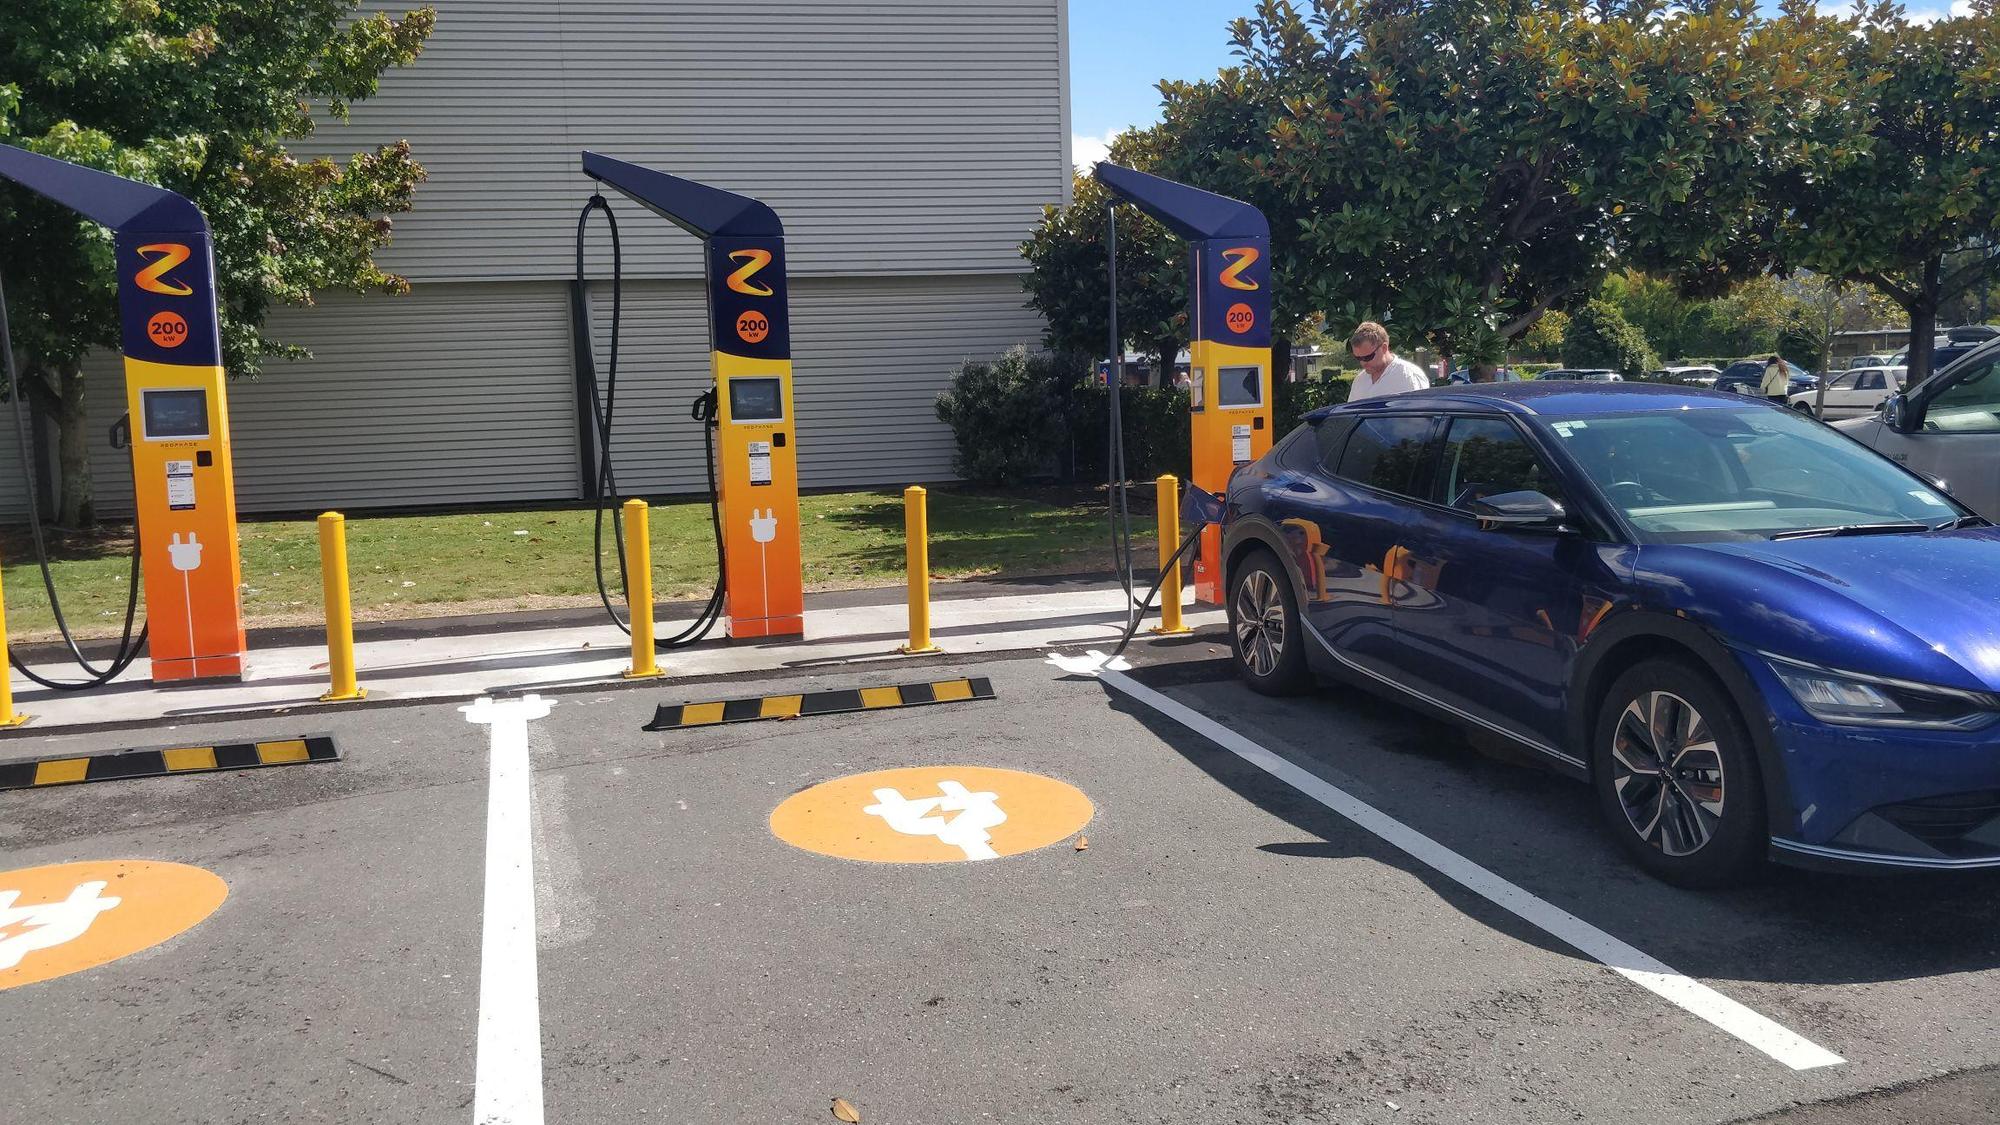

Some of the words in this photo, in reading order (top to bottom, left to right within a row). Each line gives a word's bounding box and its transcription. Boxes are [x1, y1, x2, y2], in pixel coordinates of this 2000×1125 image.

[135, 243, 193, 295] Z
[727, 249, 774, 296] Z
[1219, 247, 1259, 290] Z
[152, 322, 185, 334] 200
[740, 320, 767, 331] 200
[1229, 312, 1252, 322] 200
